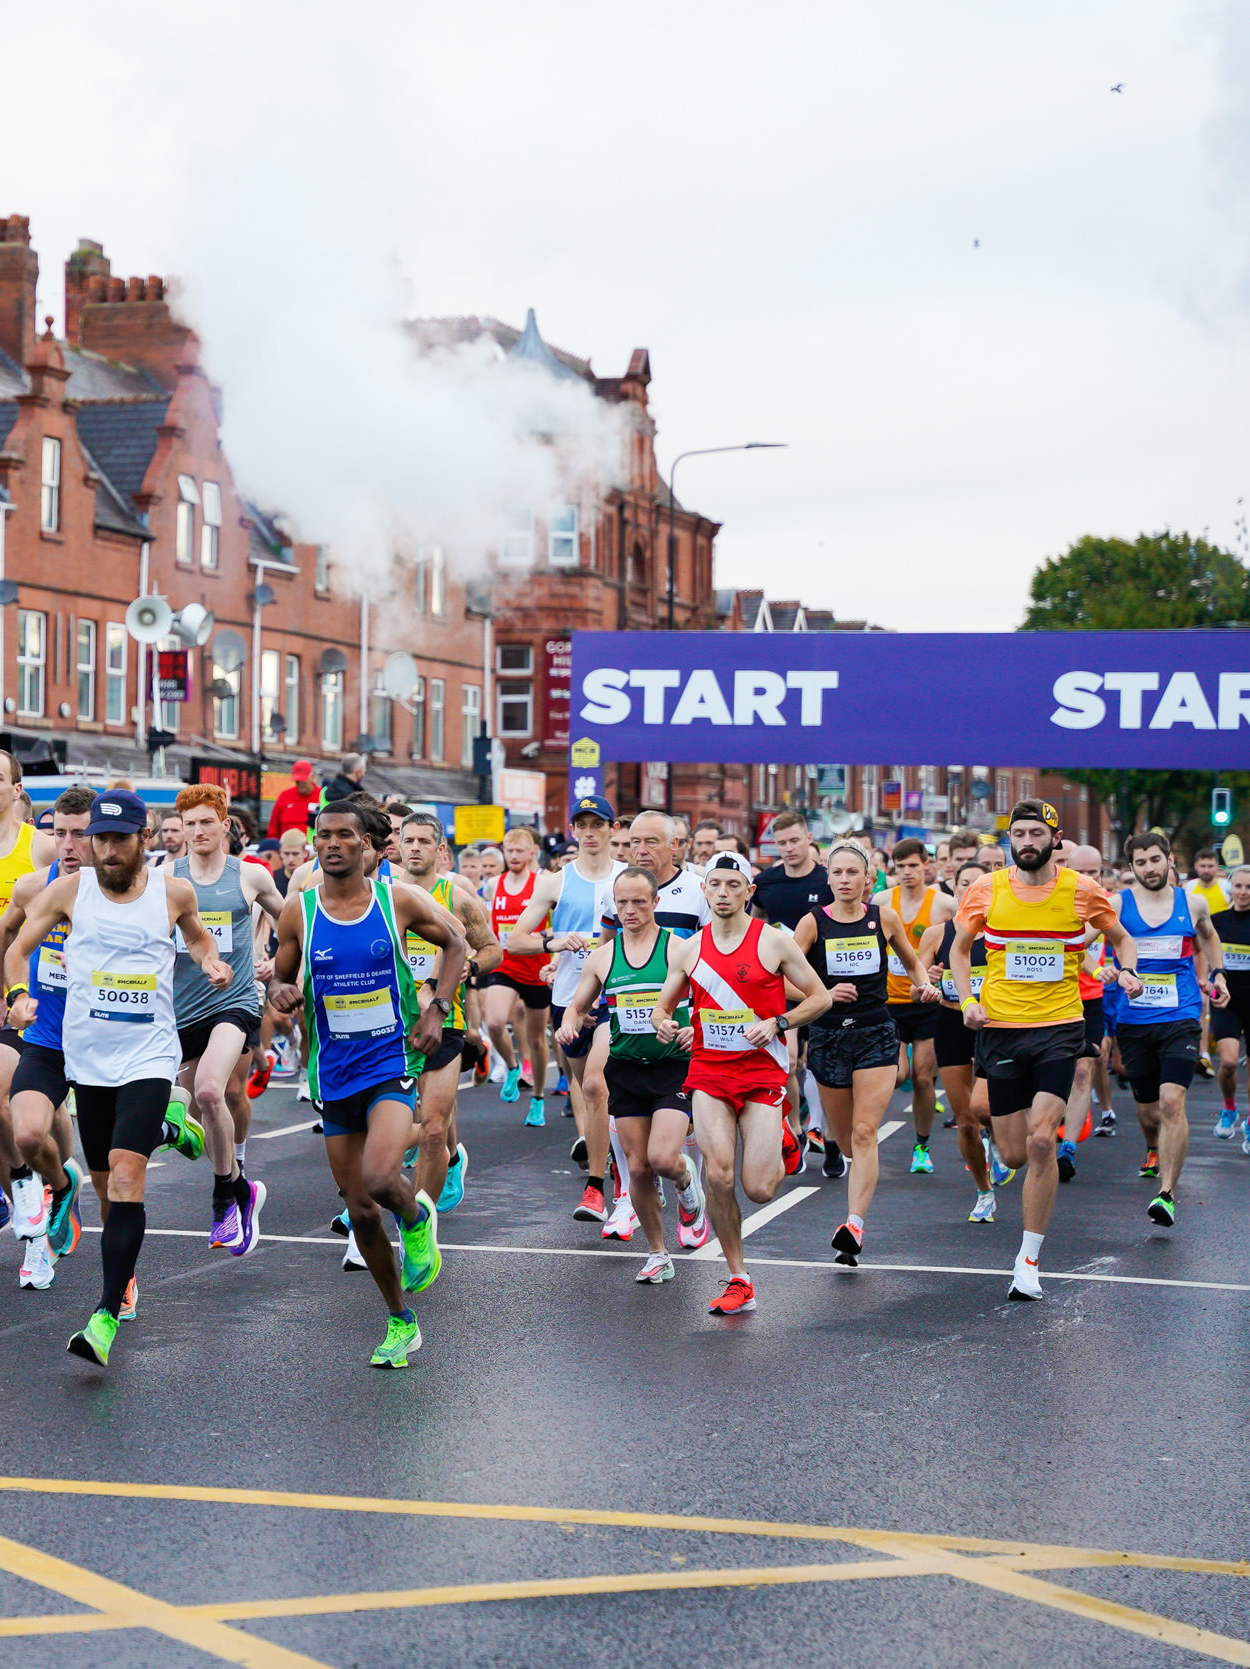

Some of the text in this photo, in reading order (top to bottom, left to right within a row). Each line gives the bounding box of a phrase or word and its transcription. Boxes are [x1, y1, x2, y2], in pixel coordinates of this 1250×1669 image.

[579, 668, 839, 727] START
[1050, 671, 1250, 729] STAR
[835, 950, 872, 963] 51669
[1014, 955, 1056, 967] 51002
[334, 972, 366, 980] SHEFFIELD
[98, 989, 150, 1004] 50038
[1143, 986, 1170, 996] 1641
[625, 1008, 654, 1020] 5157
[709, 1025, 745, 1036] 51574
